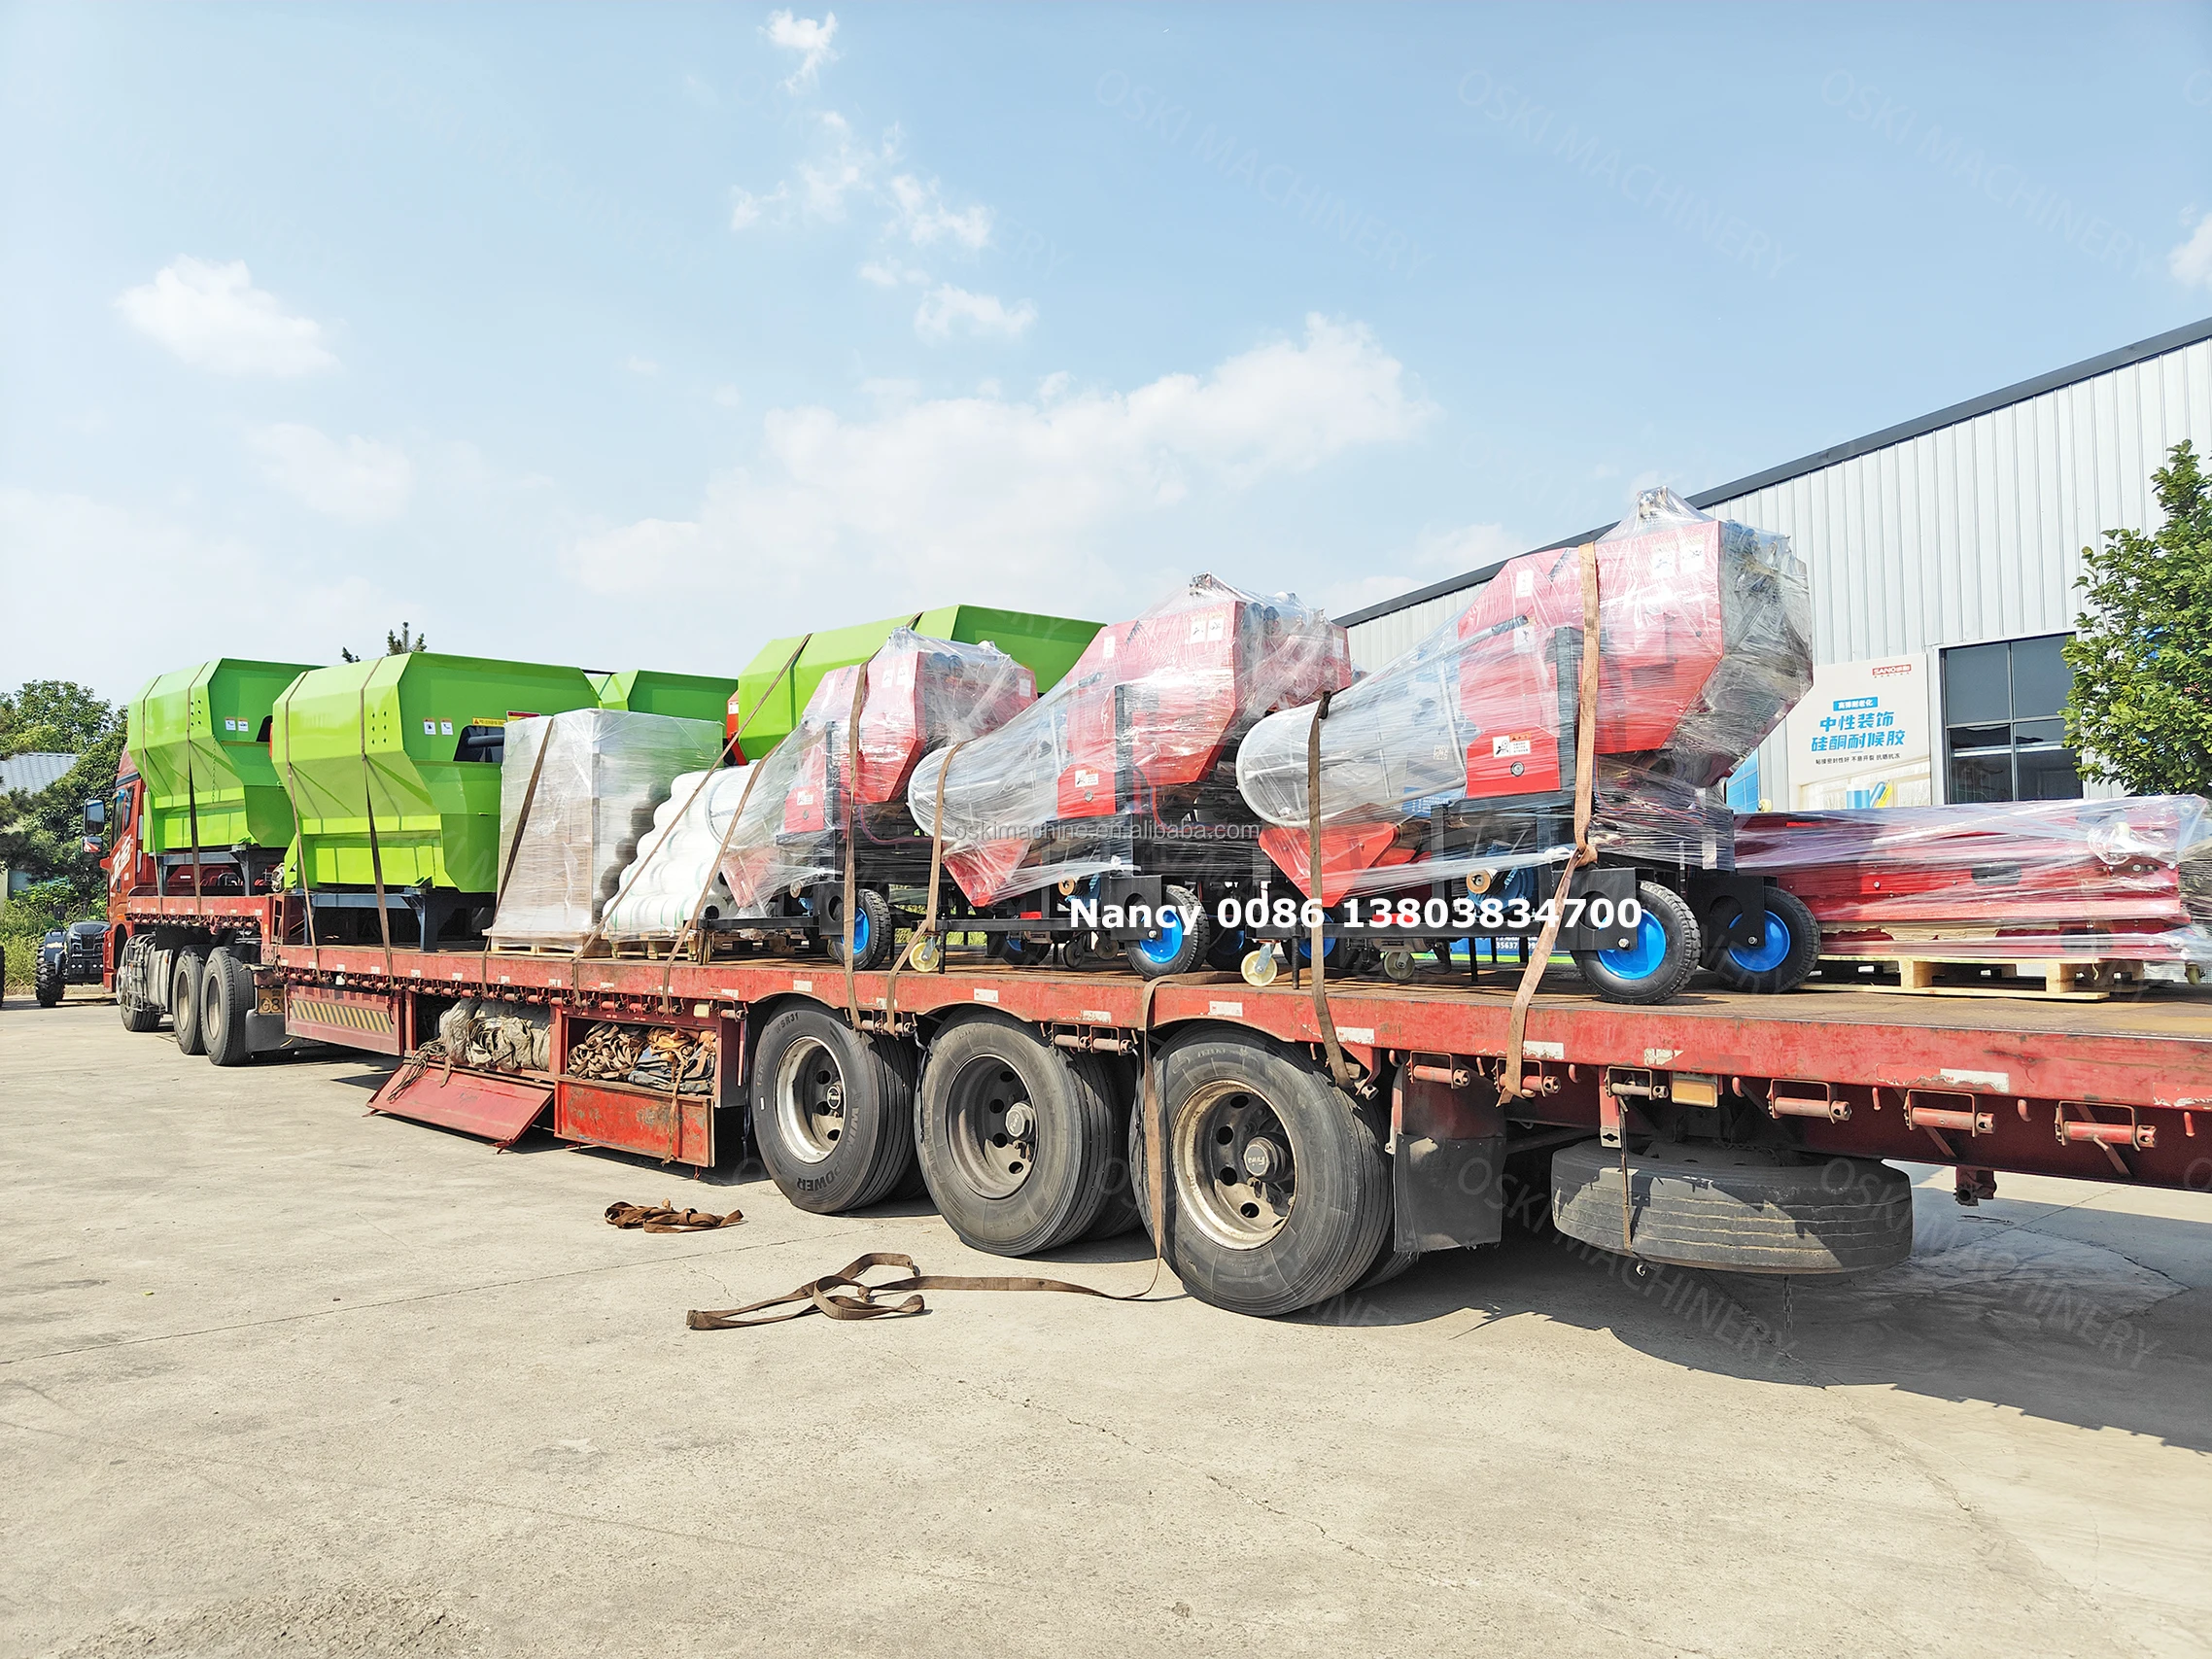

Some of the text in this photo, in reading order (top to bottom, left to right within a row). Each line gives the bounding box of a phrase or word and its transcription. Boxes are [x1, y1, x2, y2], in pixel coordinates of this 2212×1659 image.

[1819, 710, 1894, 732] 中性装饰
[1811, 730, 1906, 752] 硅酮耐候胶
